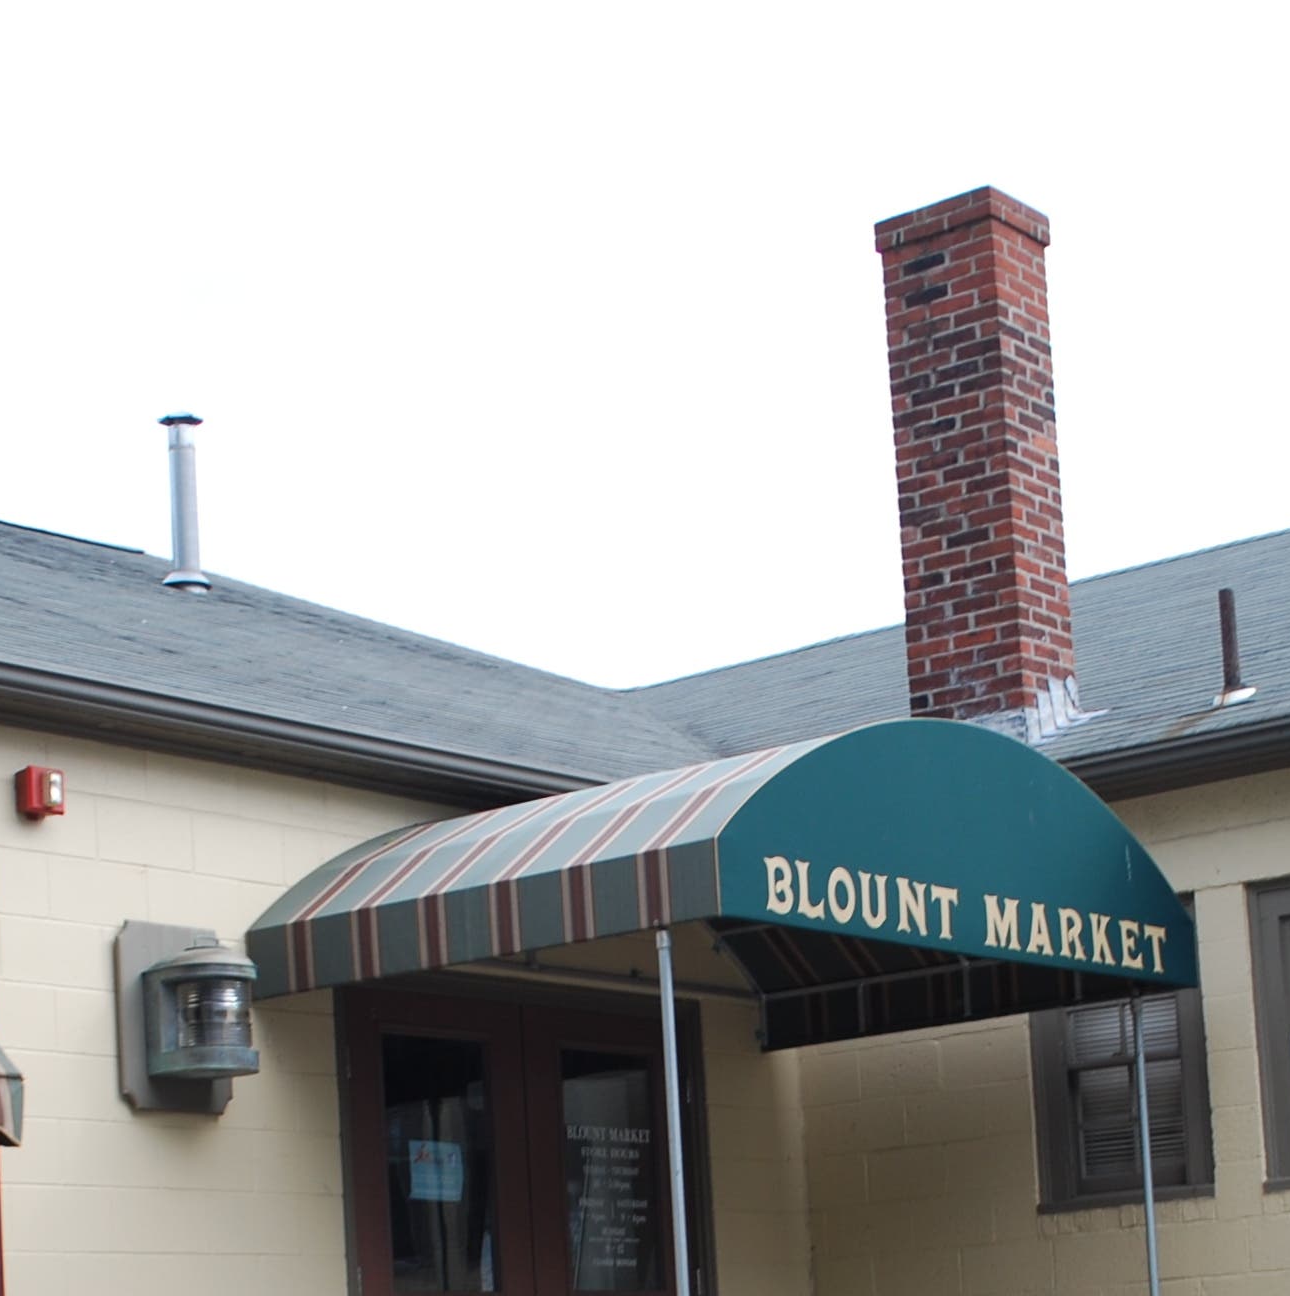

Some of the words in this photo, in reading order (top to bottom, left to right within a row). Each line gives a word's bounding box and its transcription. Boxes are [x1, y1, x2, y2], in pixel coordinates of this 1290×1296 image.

[763, 855, 959, 940] BLOUNT
[982, 893, 1167, 974] MARKET
[609, 1127, 651, 1143] MARKET
